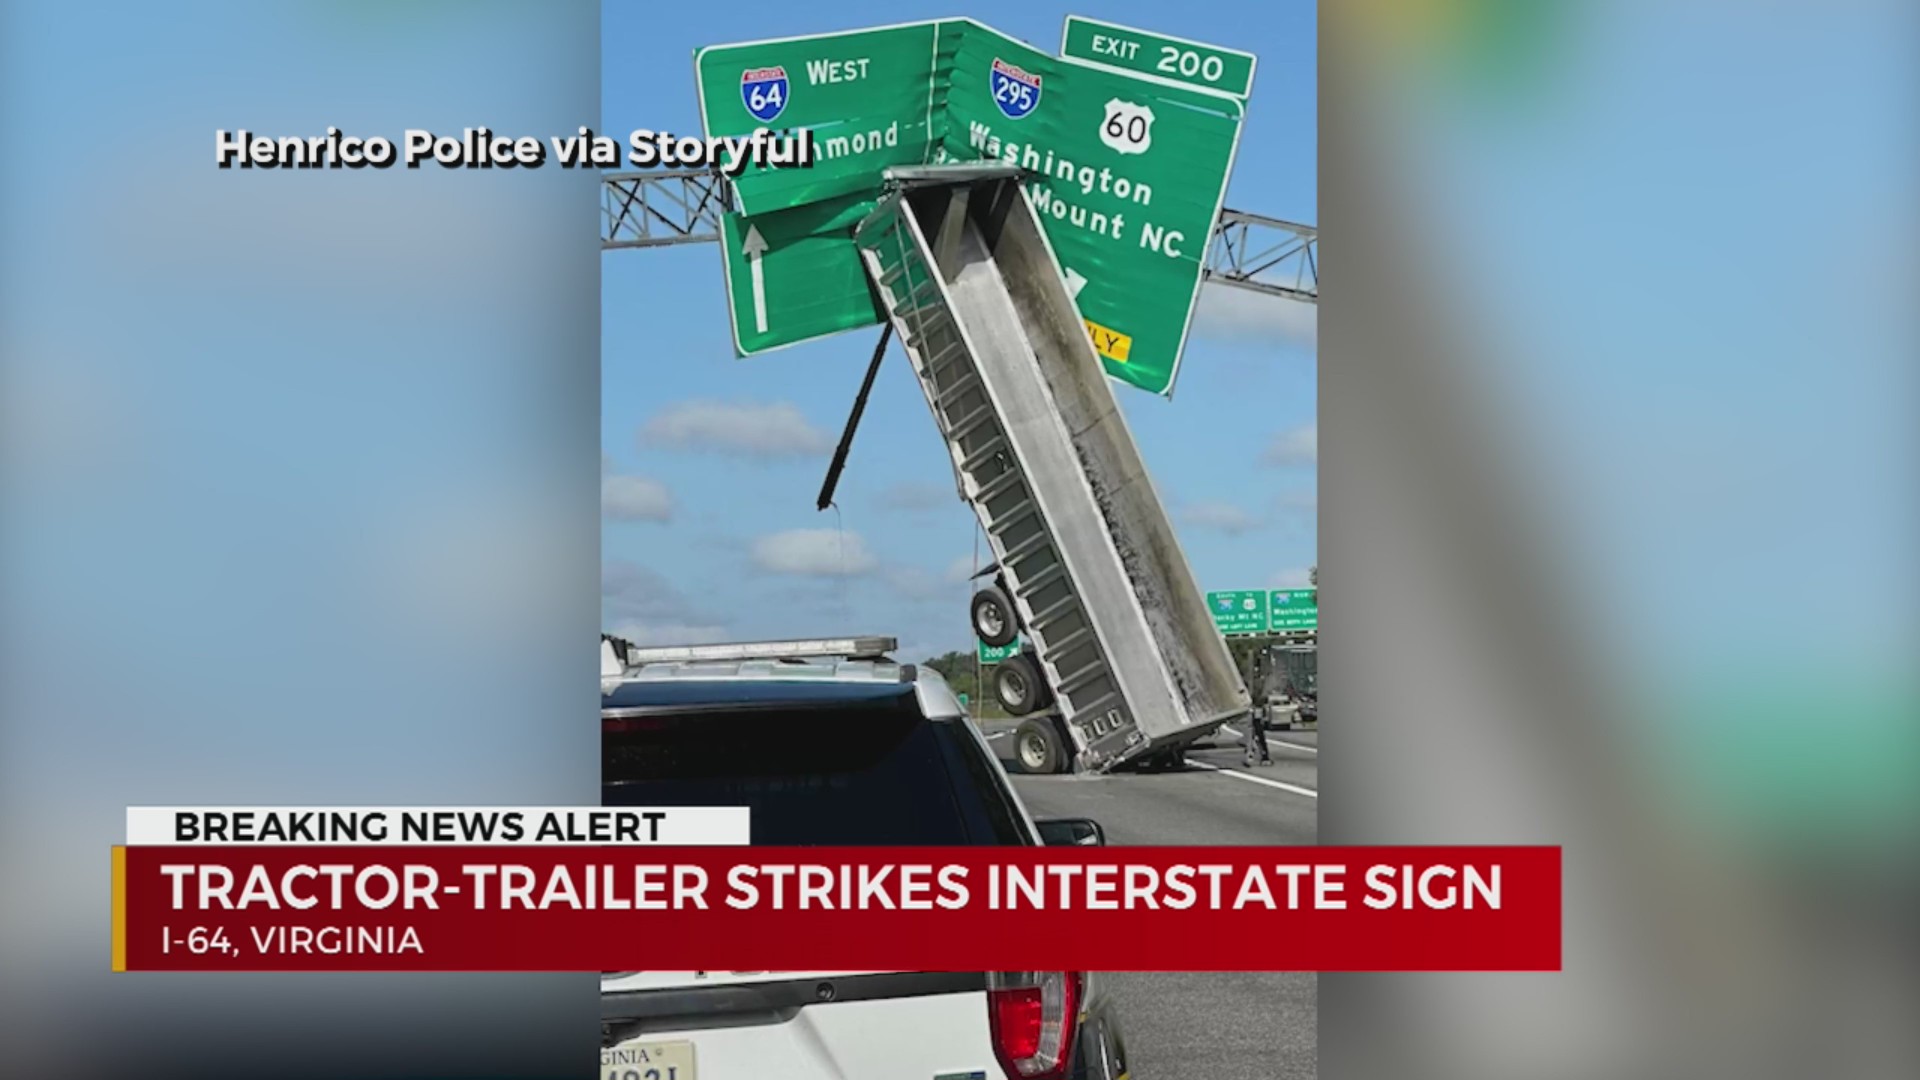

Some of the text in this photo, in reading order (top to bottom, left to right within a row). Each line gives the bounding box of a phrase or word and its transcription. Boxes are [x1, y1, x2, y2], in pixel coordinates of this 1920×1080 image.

[1091, 34, 1224, 82] EXIT 200
[750, 57, 870, 111] 64 WEST
[996, 76, 1032, 110] 295
[1106, 111, 1147, 143] 60
[970, 120, 1152, 206] Washington
[1031, 183, 1186, 257] Mount NC
